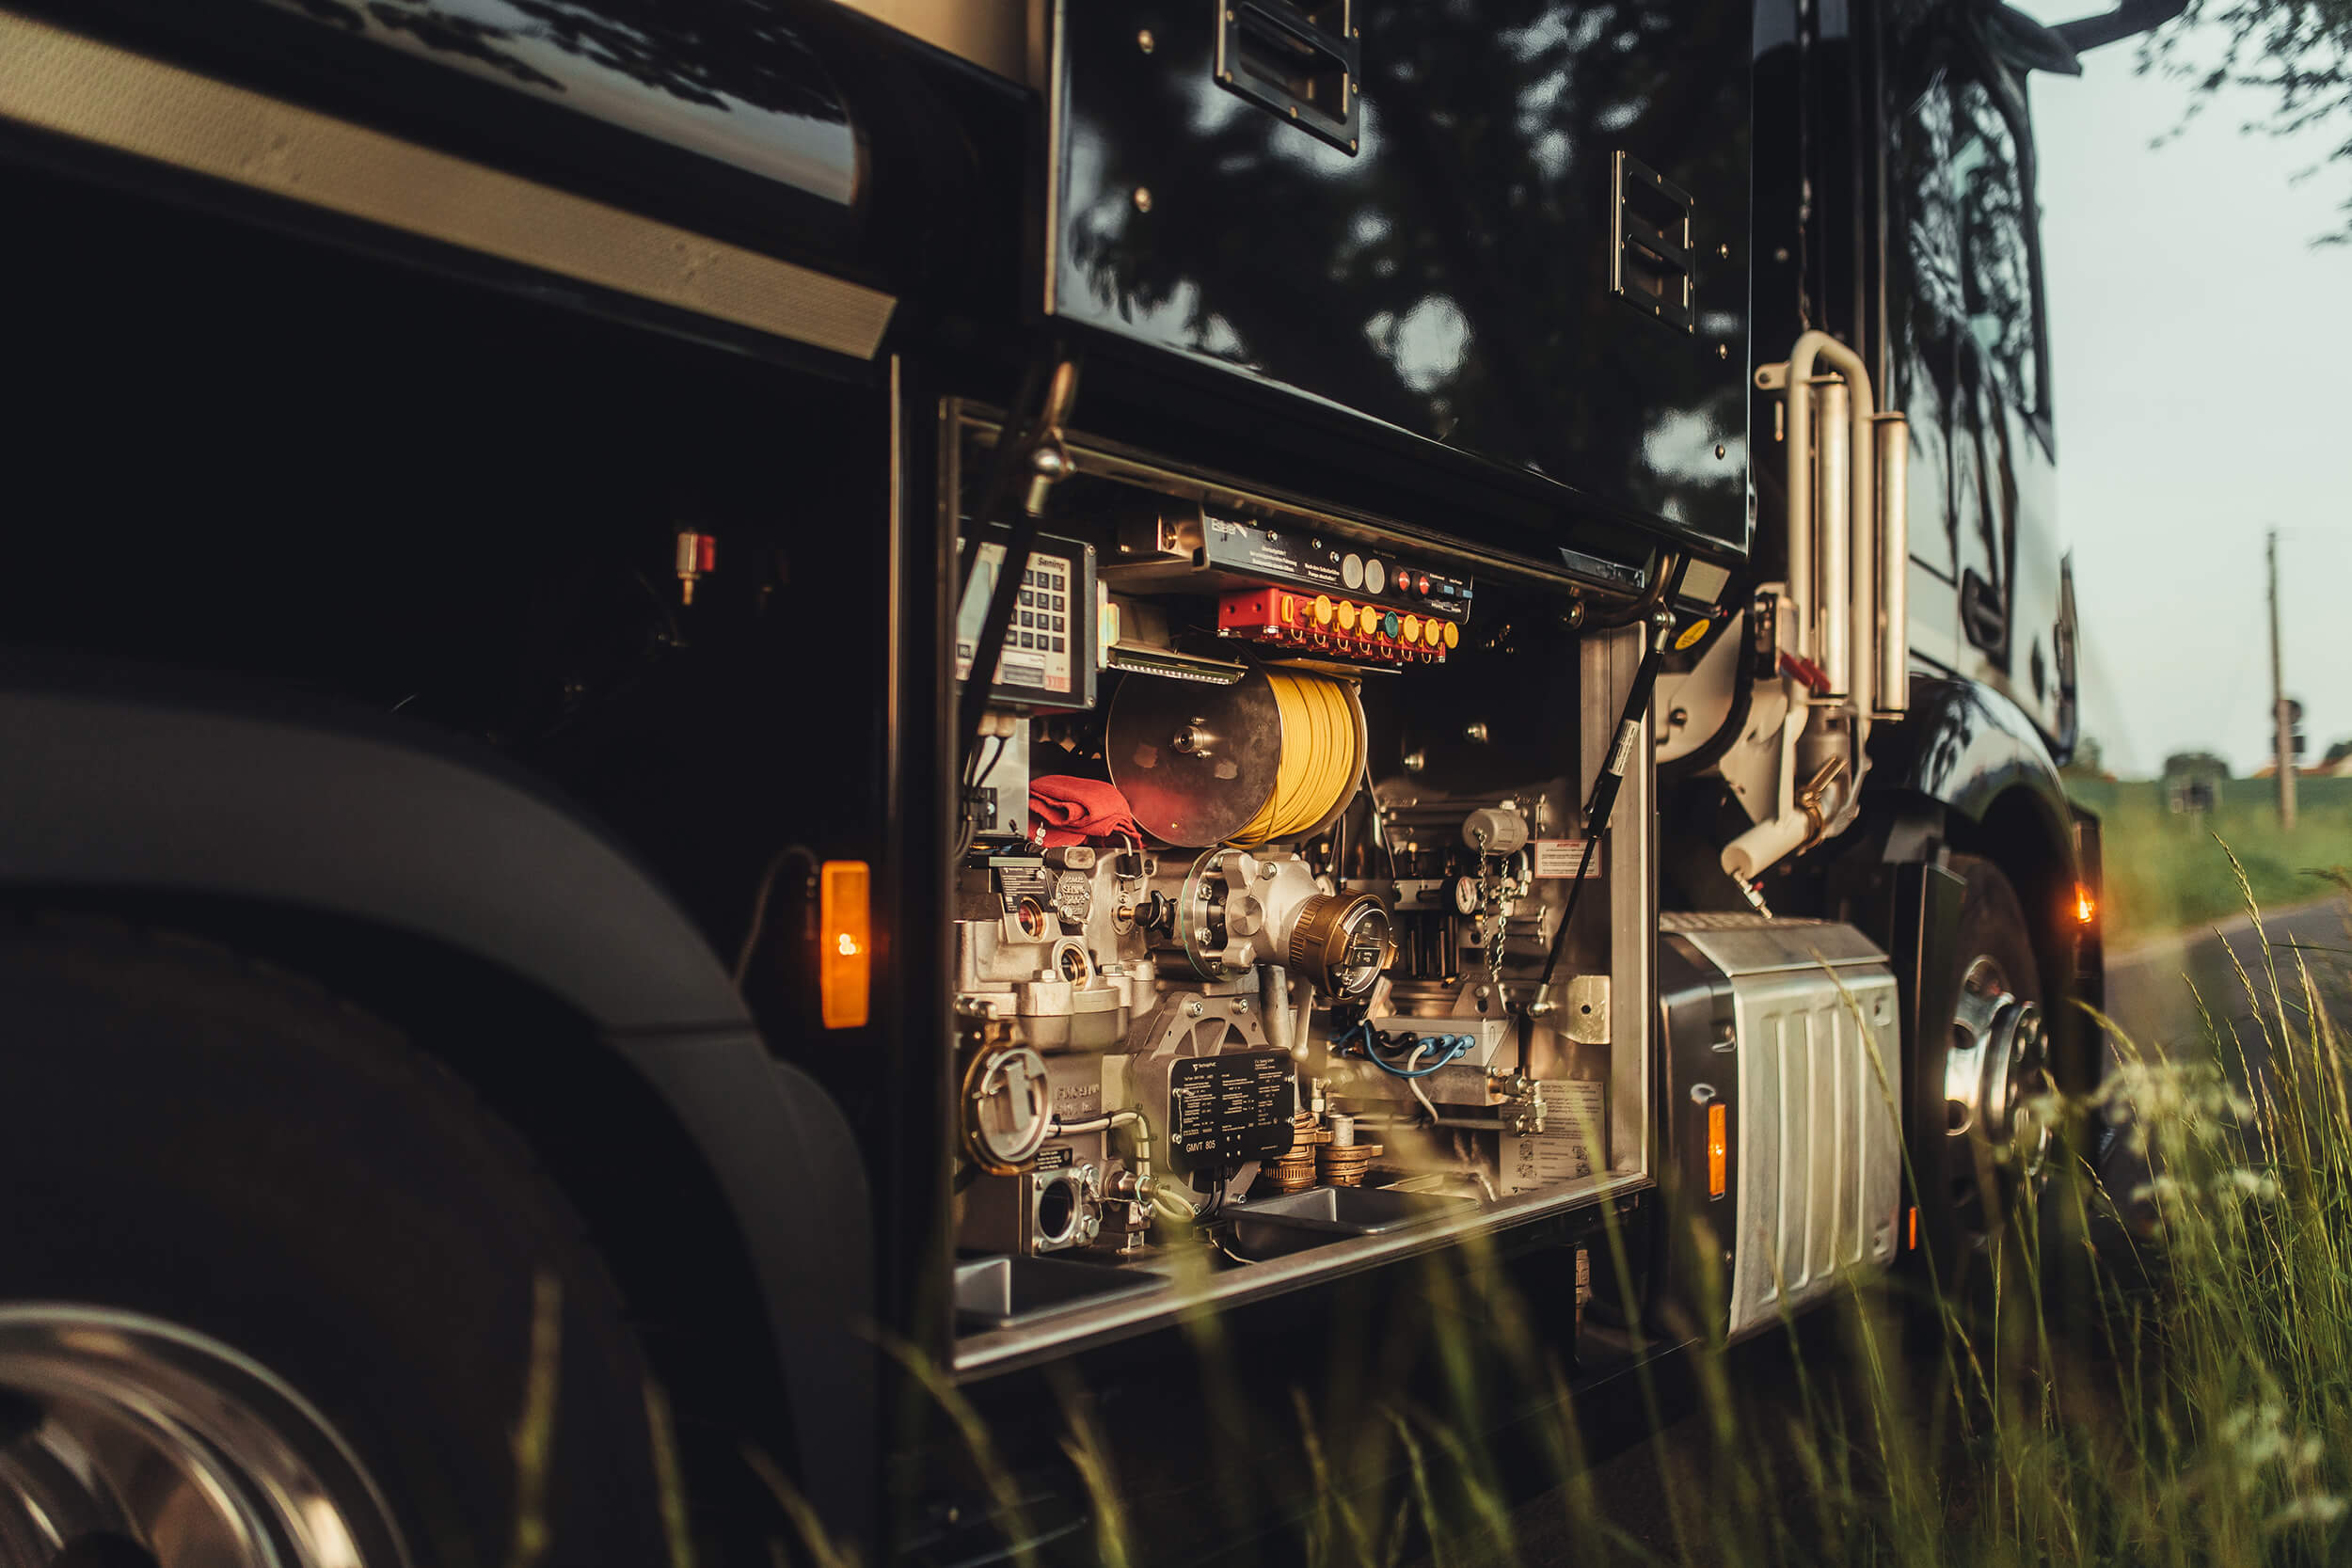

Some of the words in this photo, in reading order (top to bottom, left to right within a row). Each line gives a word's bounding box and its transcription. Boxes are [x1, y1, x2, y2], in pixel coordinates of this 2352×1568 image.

[1038, 557, 1065, 572] Sening
[1185, 1141, 1203, 1152] GMVT
[1205, 1139, 1216, 1150] 805
